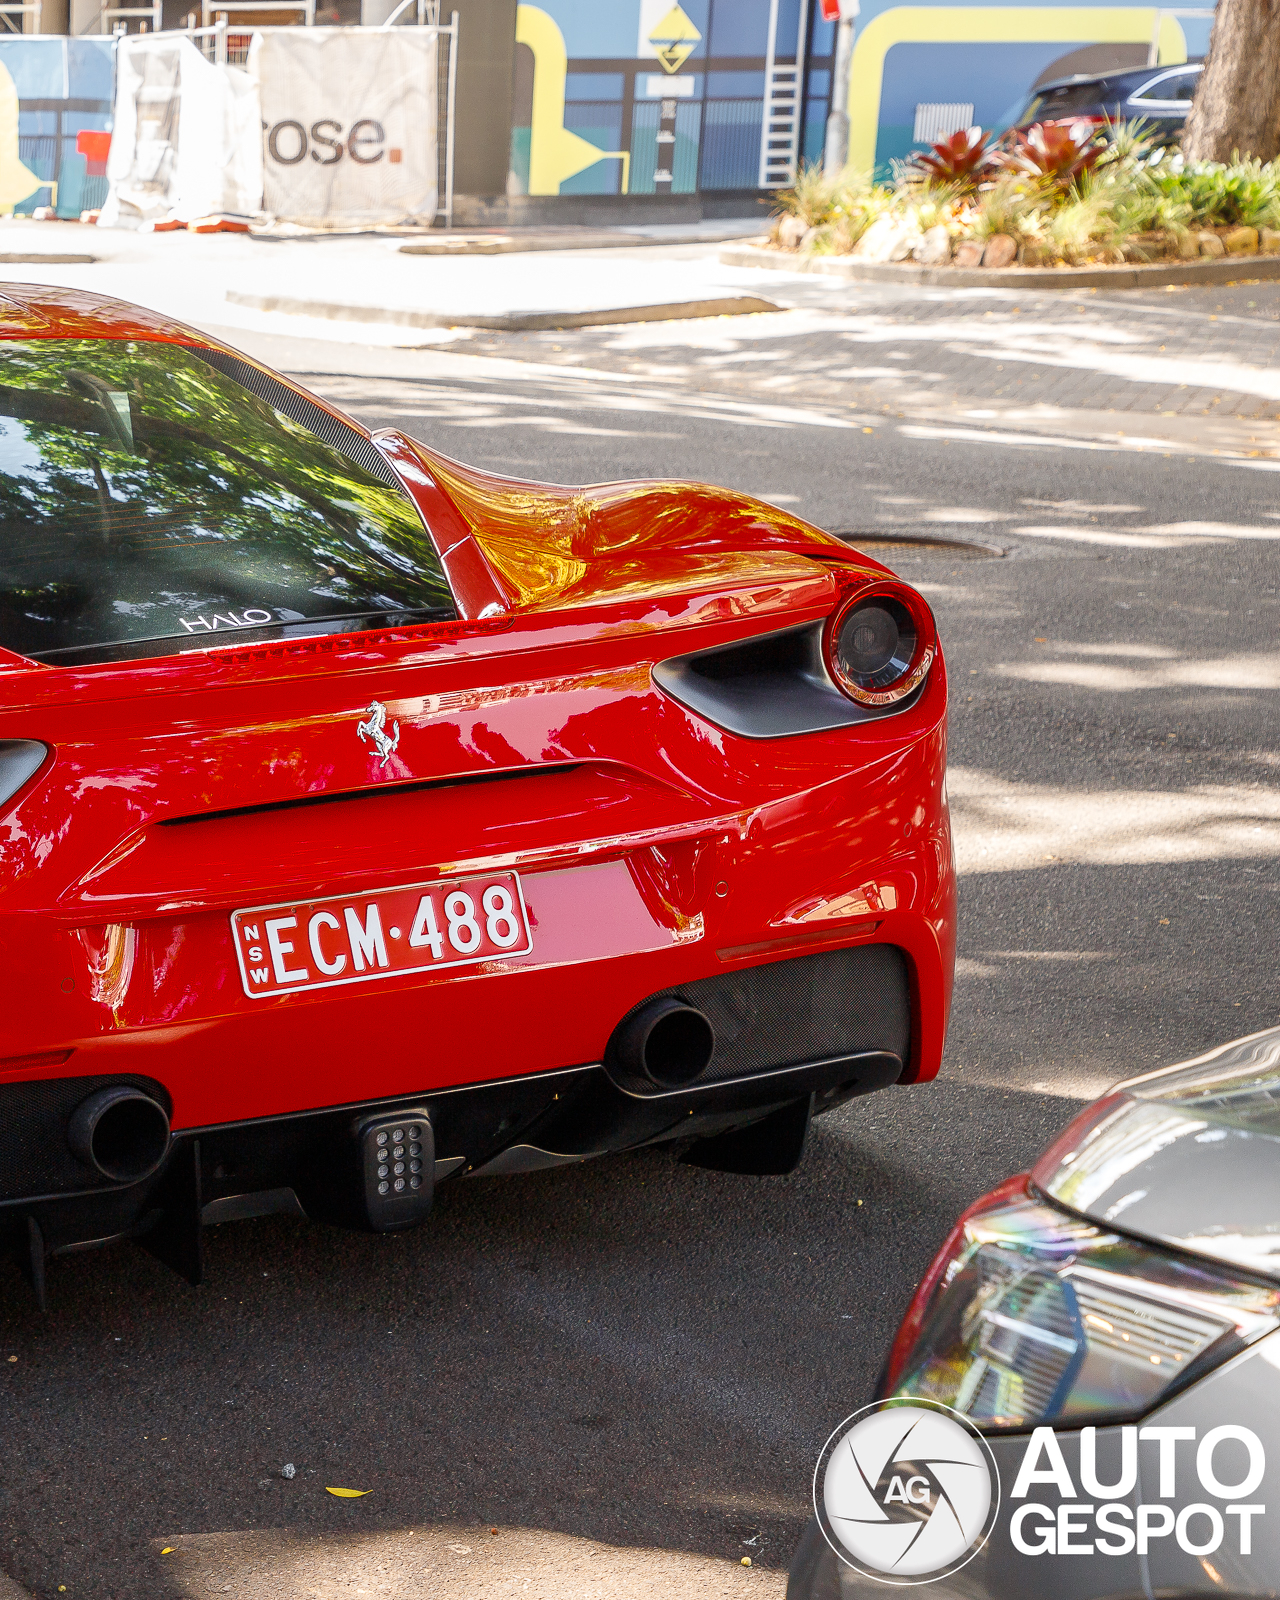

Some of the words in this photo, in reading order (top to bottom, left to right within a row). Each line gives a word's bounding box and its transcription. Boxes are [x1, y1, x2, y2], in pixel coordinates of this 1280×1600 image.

[262, 119, 402, 165] ose.
[179, 609, 272, 633] HALO
[244, 925, 269, 985] NSW
